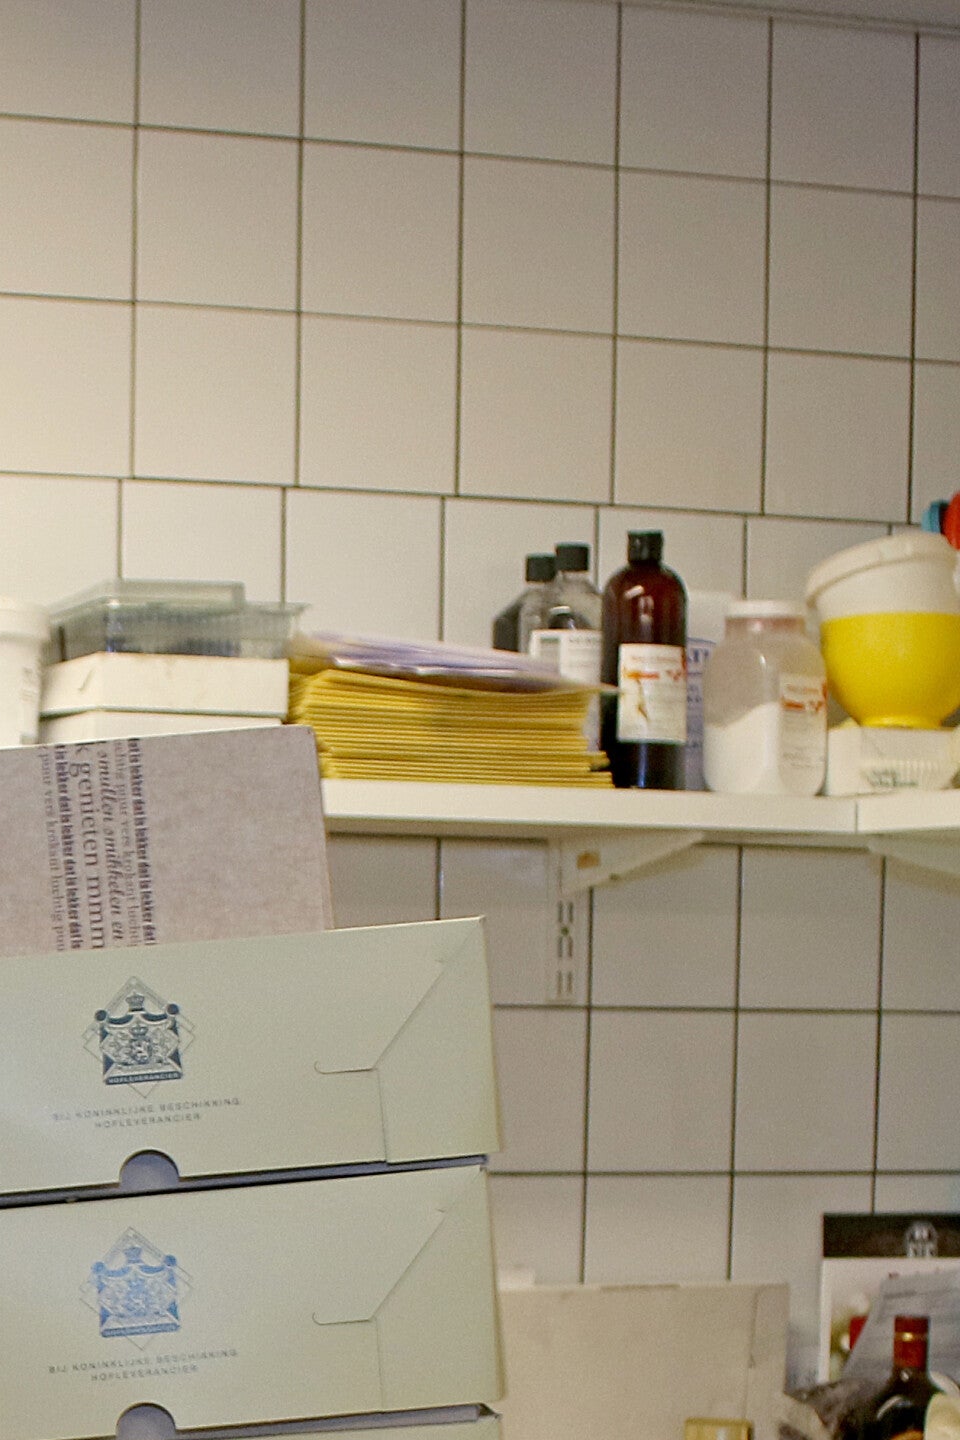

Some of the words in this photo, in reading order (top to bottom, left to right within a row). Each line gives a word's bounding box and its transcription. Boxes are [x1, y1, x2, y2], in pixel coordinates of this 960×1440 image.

[56, 762, 70, 794] lekker
[97, 749, 116, 822] smullen
[130, 765, 143, 796] lekker
[59, 796, 72, 812] dat
[132, 799, 146, 815] dat
[46, 820, 62, 871] krokant
[61, 825, 75, 857] lekker
[71, 760, 102, 867] genieten
[87, 876, 105, 950] mmm
[135, 828, 150, 860] lekker
[64, 859, 77, 875] dat
[104, 828, 124, 915] smikkelen
[123, 850, 139, 901] krokant
[138, 862, 151, 878] dat
[66, 888, 80, 920] lekker
[141, 891, 154, 923] lekker
[69, 922, 82, 938] dat
[112, 921, 122, 940] en
[143, 924, 156, 941] dat
[107, 1071, 180, 1084] HOFLEVERANCIER
[95, 1113, 200, 1128] HOFLEVERANCIER
[91, 1365, 198, 1381] HOFLEVERANCIER
